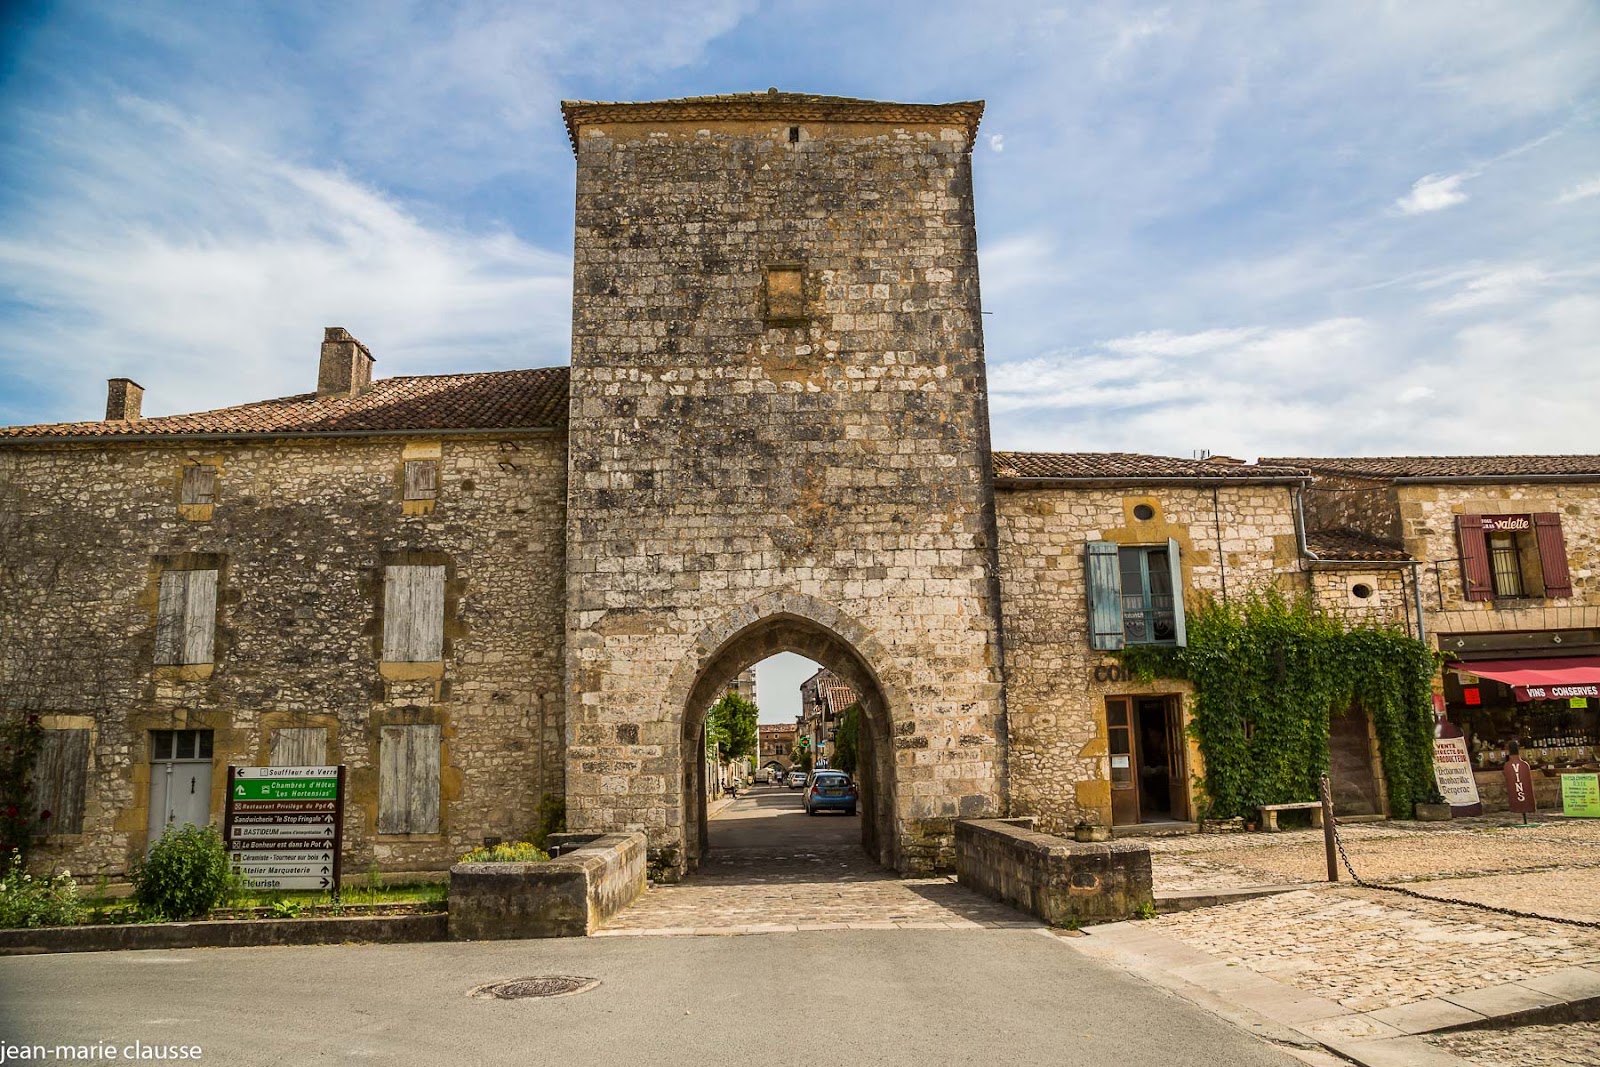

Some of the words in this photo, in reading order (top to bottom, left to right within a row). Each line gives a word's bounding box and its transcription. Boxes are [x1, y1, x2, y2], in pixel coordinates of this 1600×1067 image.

[1494, 516, 1530, 530] valette
[1526, 688, 1546, 698] VINS
[1551, 686, 1598, 696] CONSERVES
[1512, 763, 1525, 802] VINS
[283, 815, 298, 823] Stop
[241, 880, 280, 888] Fleuriste
